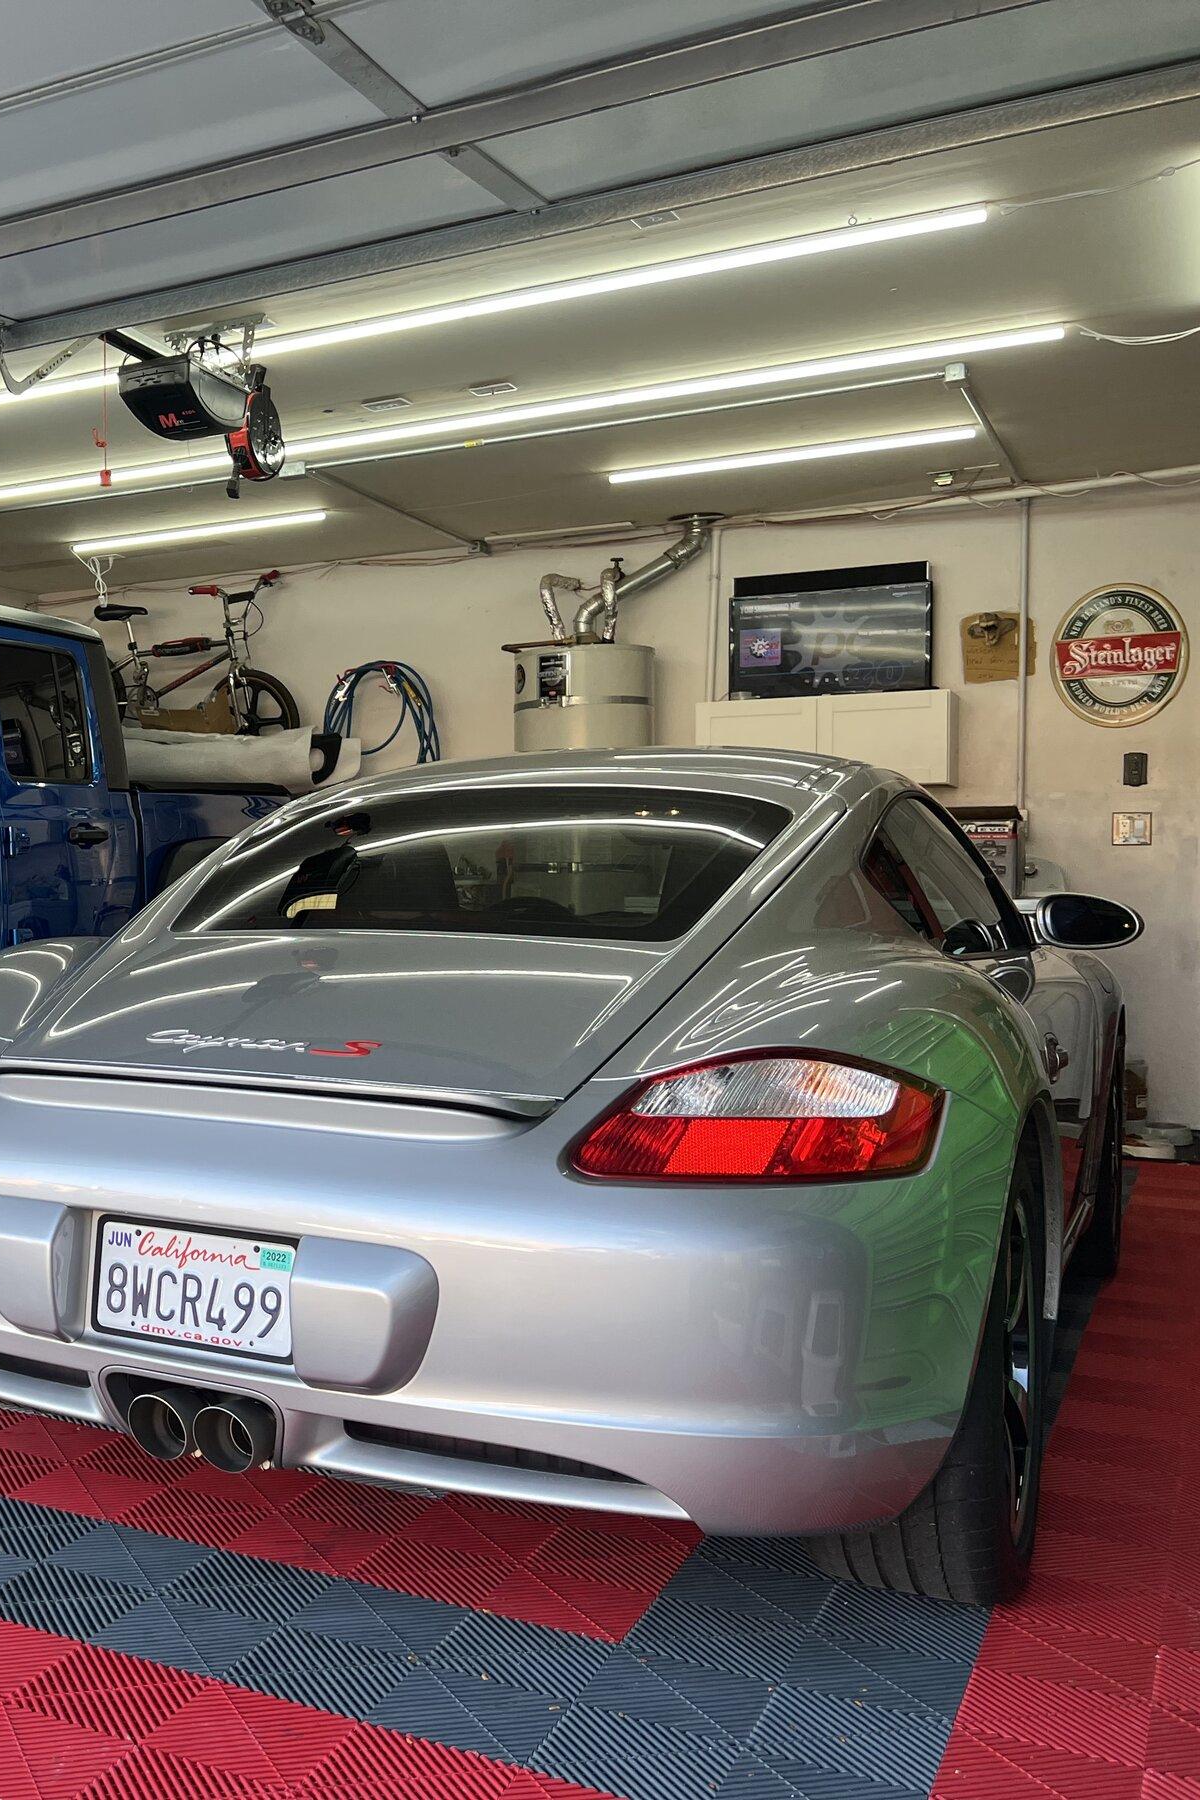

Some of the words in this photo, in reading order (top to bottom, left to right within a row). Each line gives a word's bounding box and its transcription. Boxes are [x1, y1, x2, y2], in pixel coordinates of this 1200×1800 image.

[1069, 620, 1084, 637] NEW
[1080, 595, 1122, 620] ZEALAND'S
[1124, 596, 1154, 613] FINEST
[1150, 610, 1168, 630] BEER
[1063, 637, 1177, 675] Steinlager
[1070, 681, 1095, 707] JUDGED
[1093, 703, 1128, 715] WORLD'S
[1131, 696, 1151, 712] BEST
[146, 1029, 311, 1053] Cayman
[309, 1040, 383, 1058] S
[108, 1231, 132, 1248] JUN
[138, 1231, 260, 1270] California
[265, 1251, 287, 1263] 2022
[106, 1261, 282, 1340] 8WCR499
[140, 1323, 243, 1348] dmv.ca.gov
